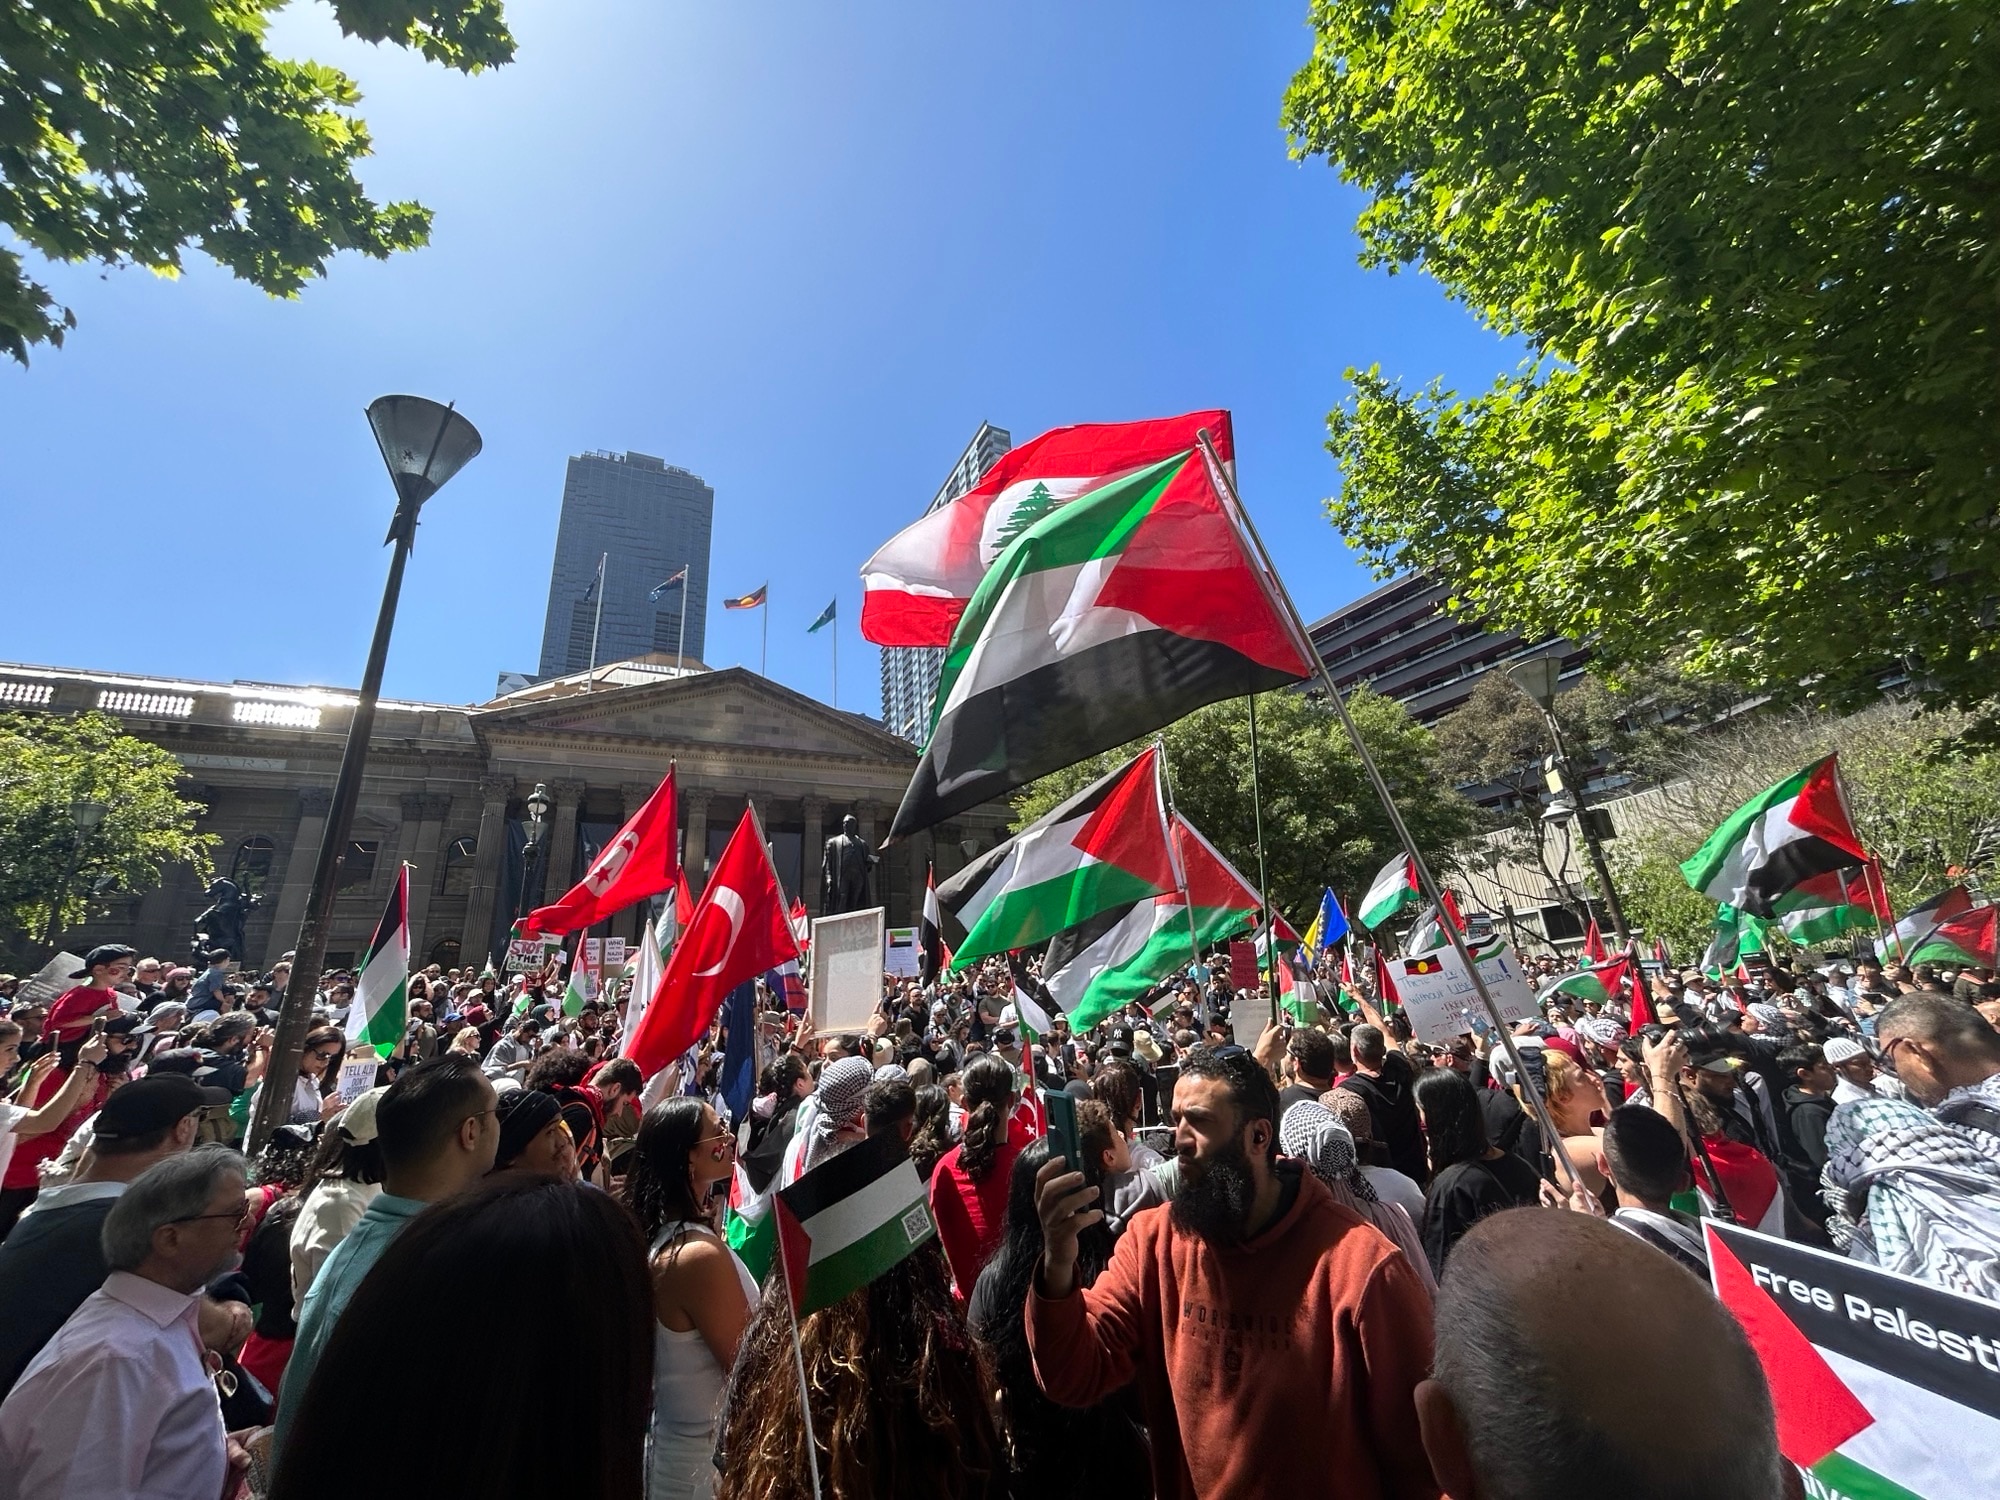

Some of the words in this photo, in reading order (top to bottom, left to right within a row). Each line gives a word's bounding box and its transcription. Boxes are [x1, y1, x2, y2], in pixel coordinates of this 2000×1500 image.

[678, 763, 784, 778] VICTORIA
[510, 940, 544, 956] STOP
[344, 1065, 361, 1076] TELL
[1750, 1263, 1836, 1312] Free
[1183, 1300, 1292, 1336] WORLDWIDE
